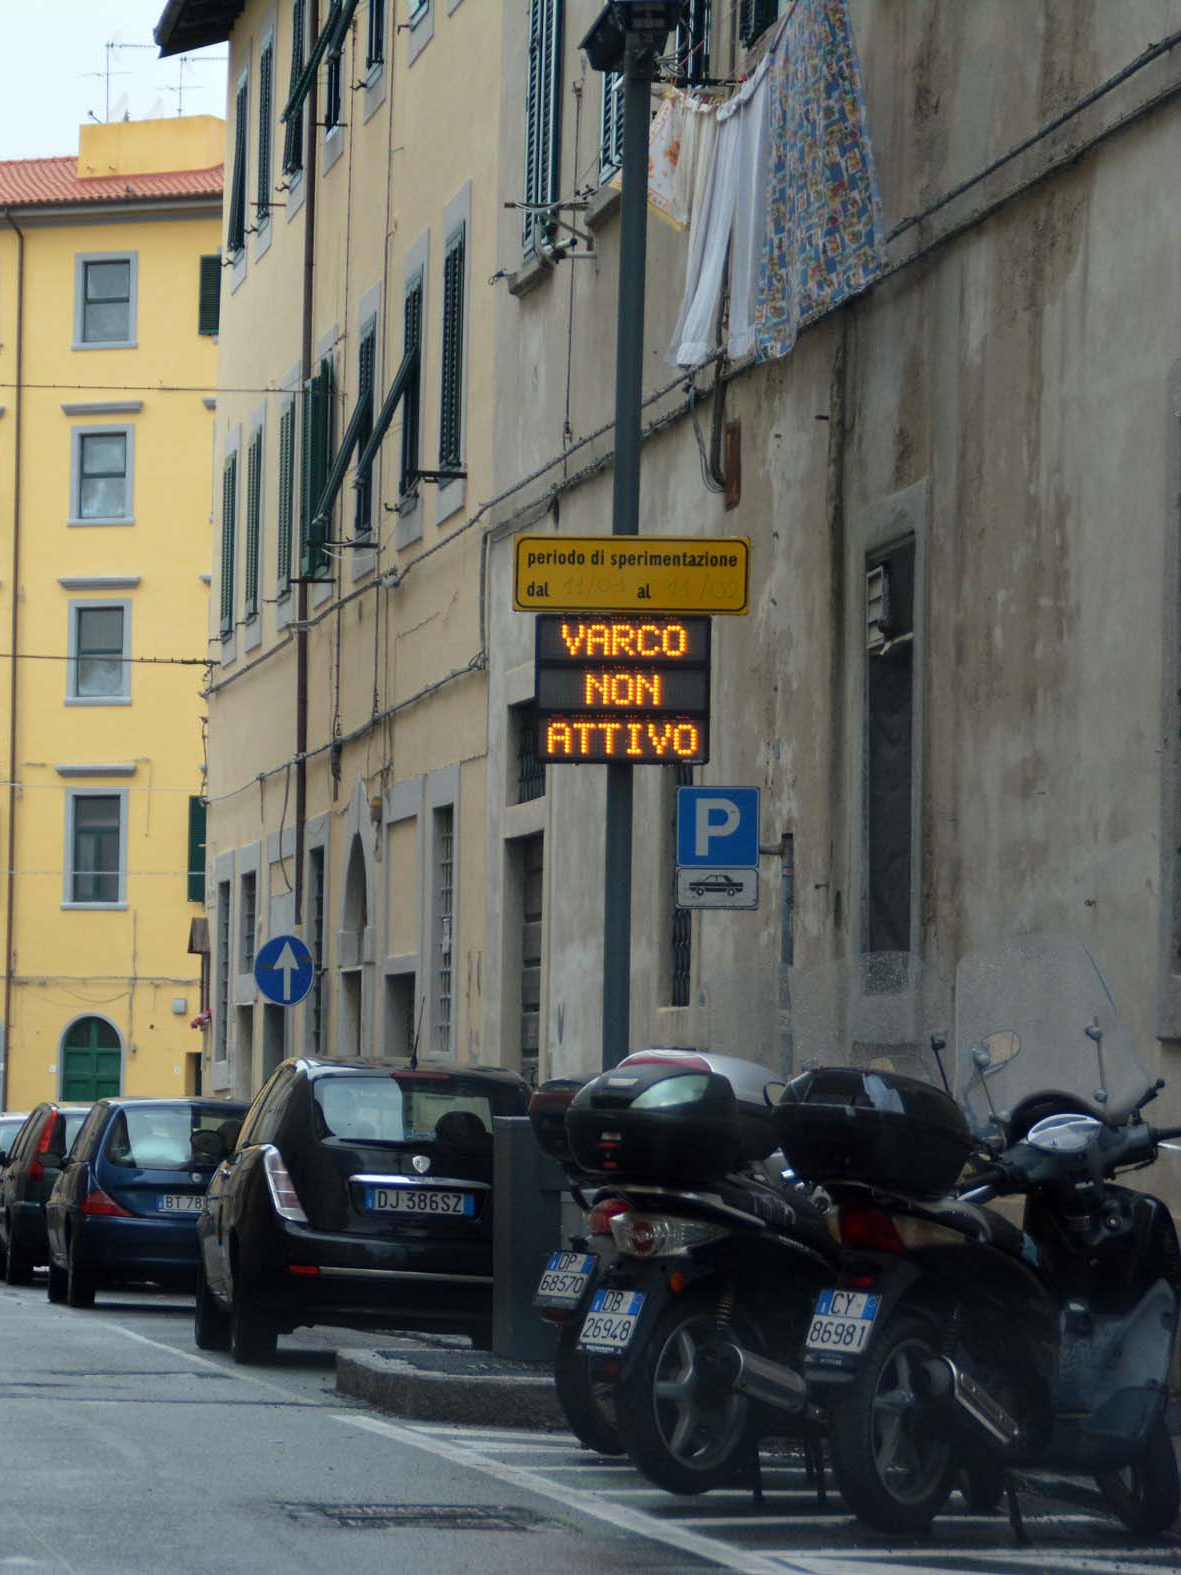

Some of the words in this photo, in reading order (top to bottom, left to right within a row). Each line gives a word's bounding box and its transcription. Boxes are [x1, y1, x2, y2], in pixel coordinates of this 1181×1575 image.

[527, 549, 586, 568] periodo
[591, 550, 605, 566] di
[610, 550, 738, 569] sperimentazione
[526, 581, 550, 597] dal
[637, 583, 651, 599] al
[562, 624, 687, 656] VARCO
[585, 673, 661, 705] NON
[547, 722, 699, 755] ATTIVO
[695, 798, 741, 856] P
[165, 1196, 180, 1209] BT
[377, 1190, 400, 1209] DJ
[405, 1191, 462, 1213] 386SZ
[557, 1253, 578, 1270] DP
[540, 1274, 585, 1294] 68570
[602, 1290, 624, 1312] DB
[830, 1292, 857, 1315] CY
[582, 1317, 632, 1341] 26948
[809, 1320, 866, 1348] 86981
